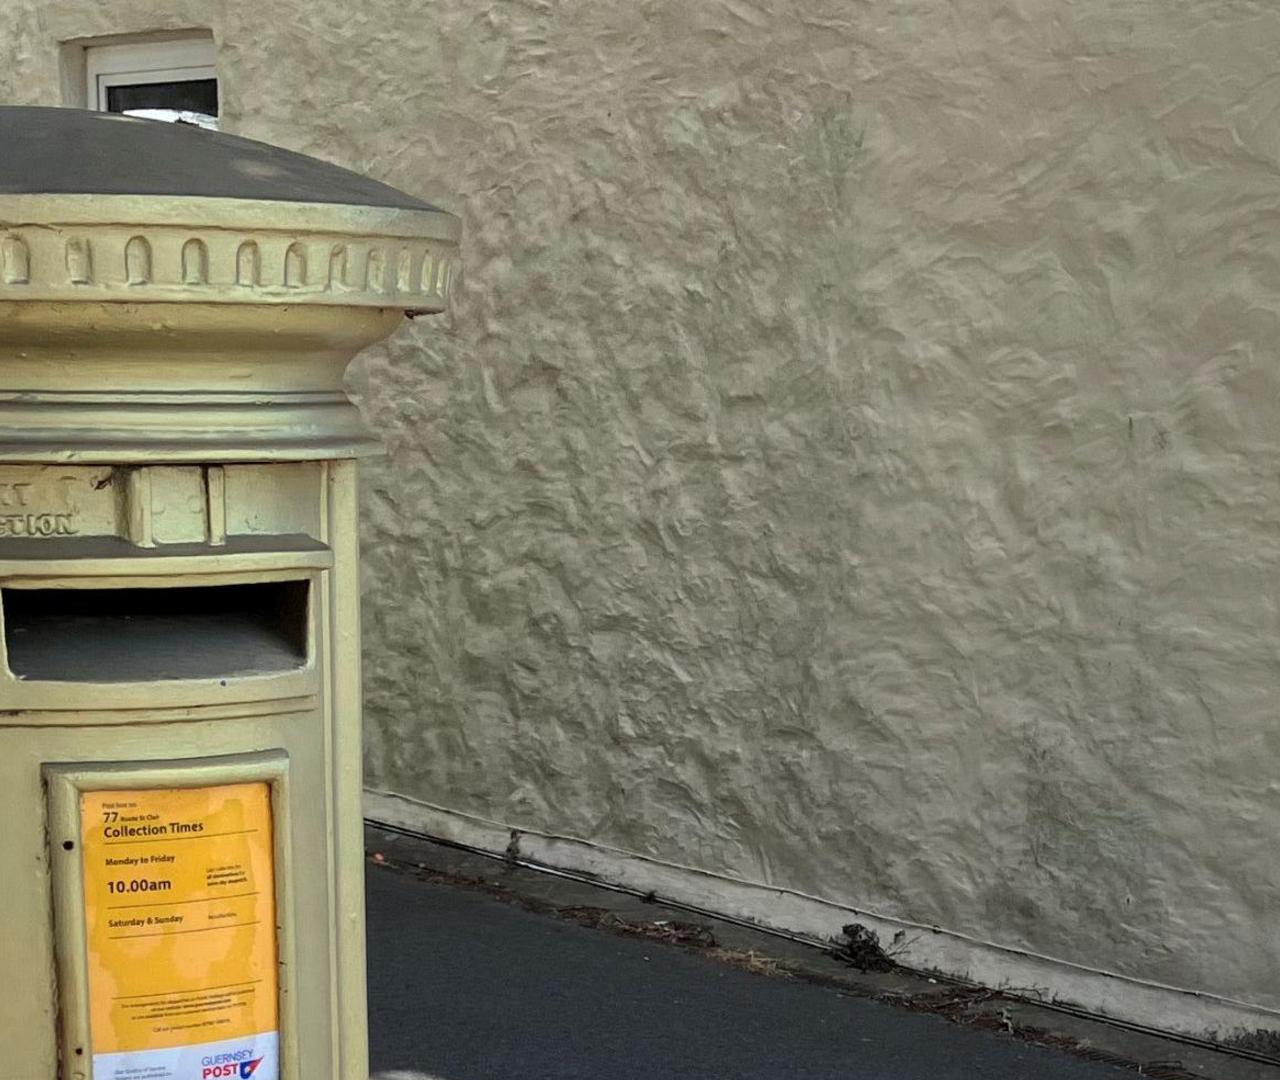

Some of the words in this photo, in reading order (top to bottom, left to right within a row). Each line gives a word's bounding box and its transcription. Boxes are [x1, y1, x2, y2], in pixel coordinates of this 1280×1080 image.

[103, 811, 119, 824] 77
[103, 824, 168, 839] Collection
[169, 821, 204, 835] Times
[105, 856, 138, 867] Monday
[140, 856, 150, 864] to
[151, 854, 176, 864] Friday
[107, 879, 172, 894] 10.00am
[108, 917, 145, 928] Saturday
[147, 917, 153, 925] &
[154, 915, 184, 925] Sunday
[201, 1049, 254, 1067] GUERNSEY
[202, 1063, 238, 1080] POST
